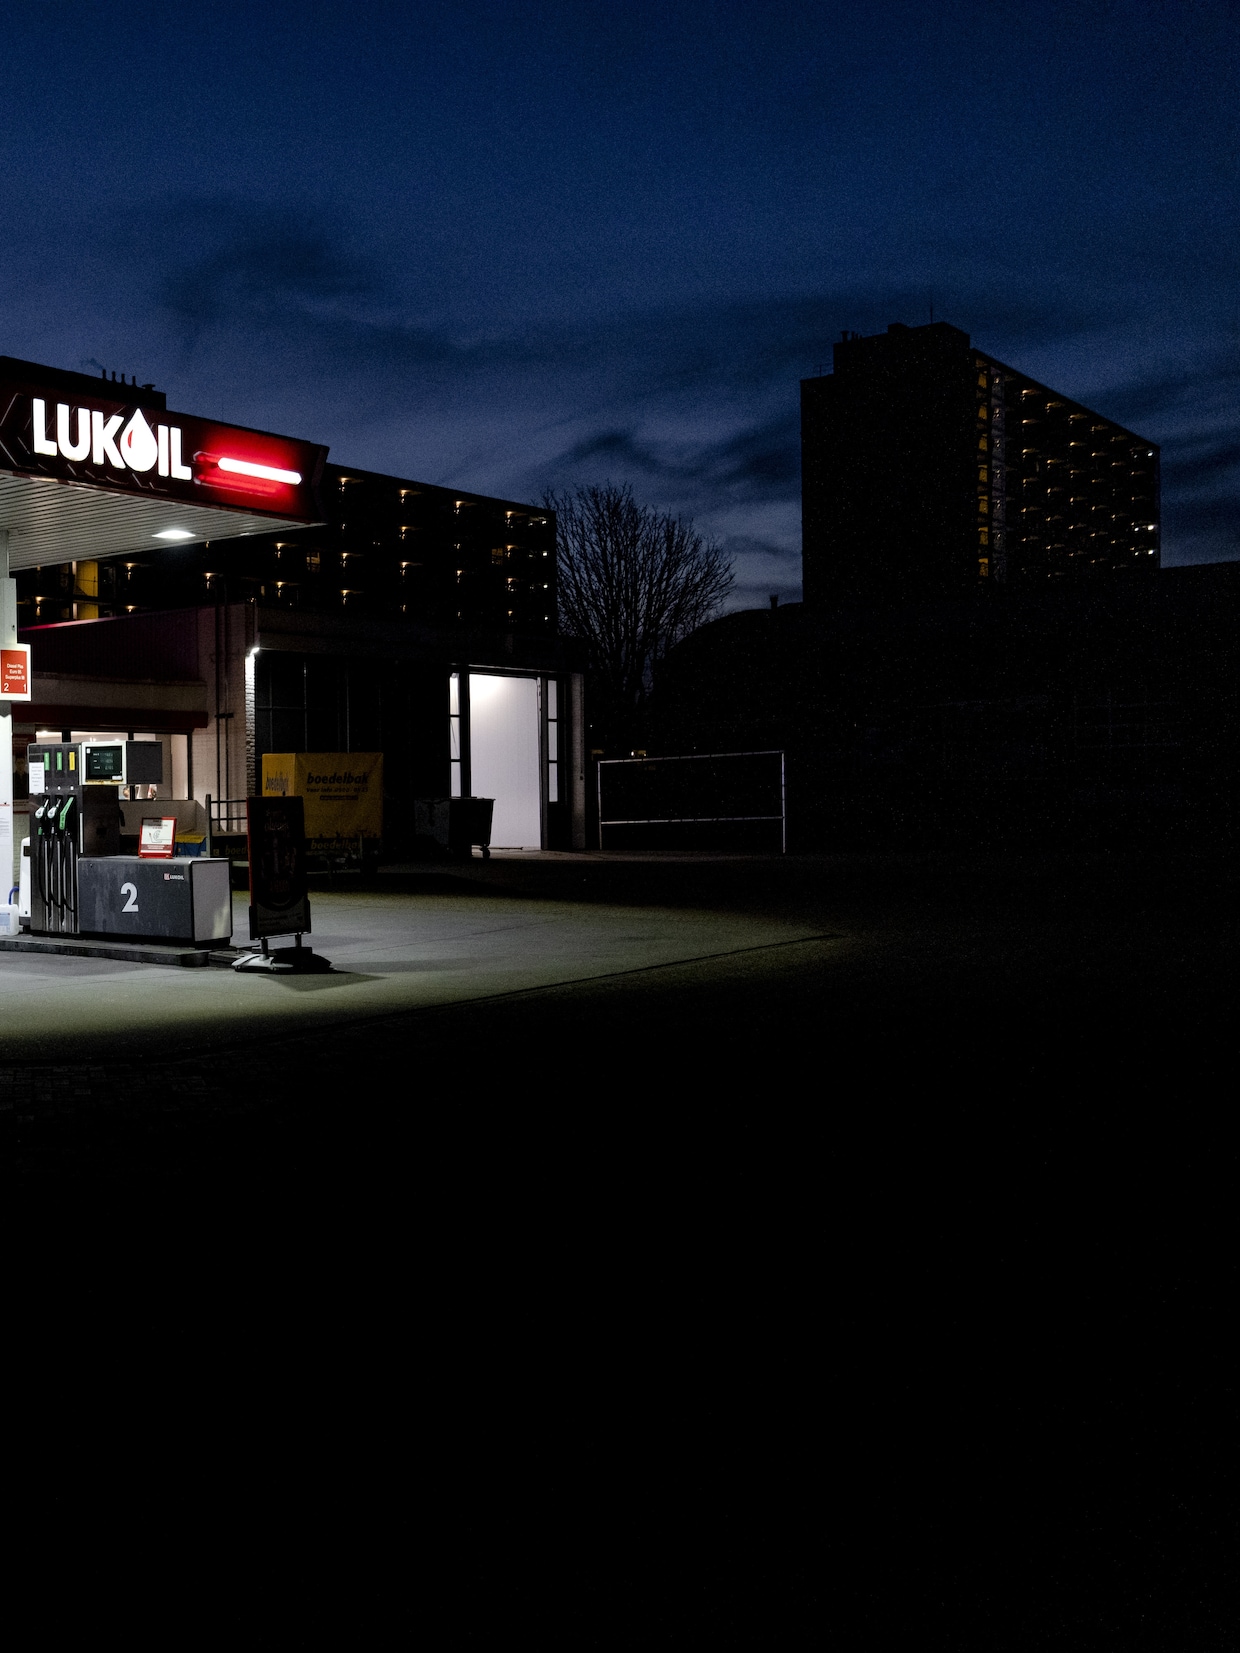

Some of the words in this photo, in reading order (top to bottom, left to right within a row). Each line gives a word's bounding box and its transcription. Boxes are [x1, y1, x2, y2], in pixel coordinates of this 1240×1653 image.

[32, 397, 193, 481] LUKOIL
[3, 682, 9, 692] 2
[23, 682, 27, 692] 1
[307, 772, 369, 784] boedelbak
[120, 882, 139, 913] 2
